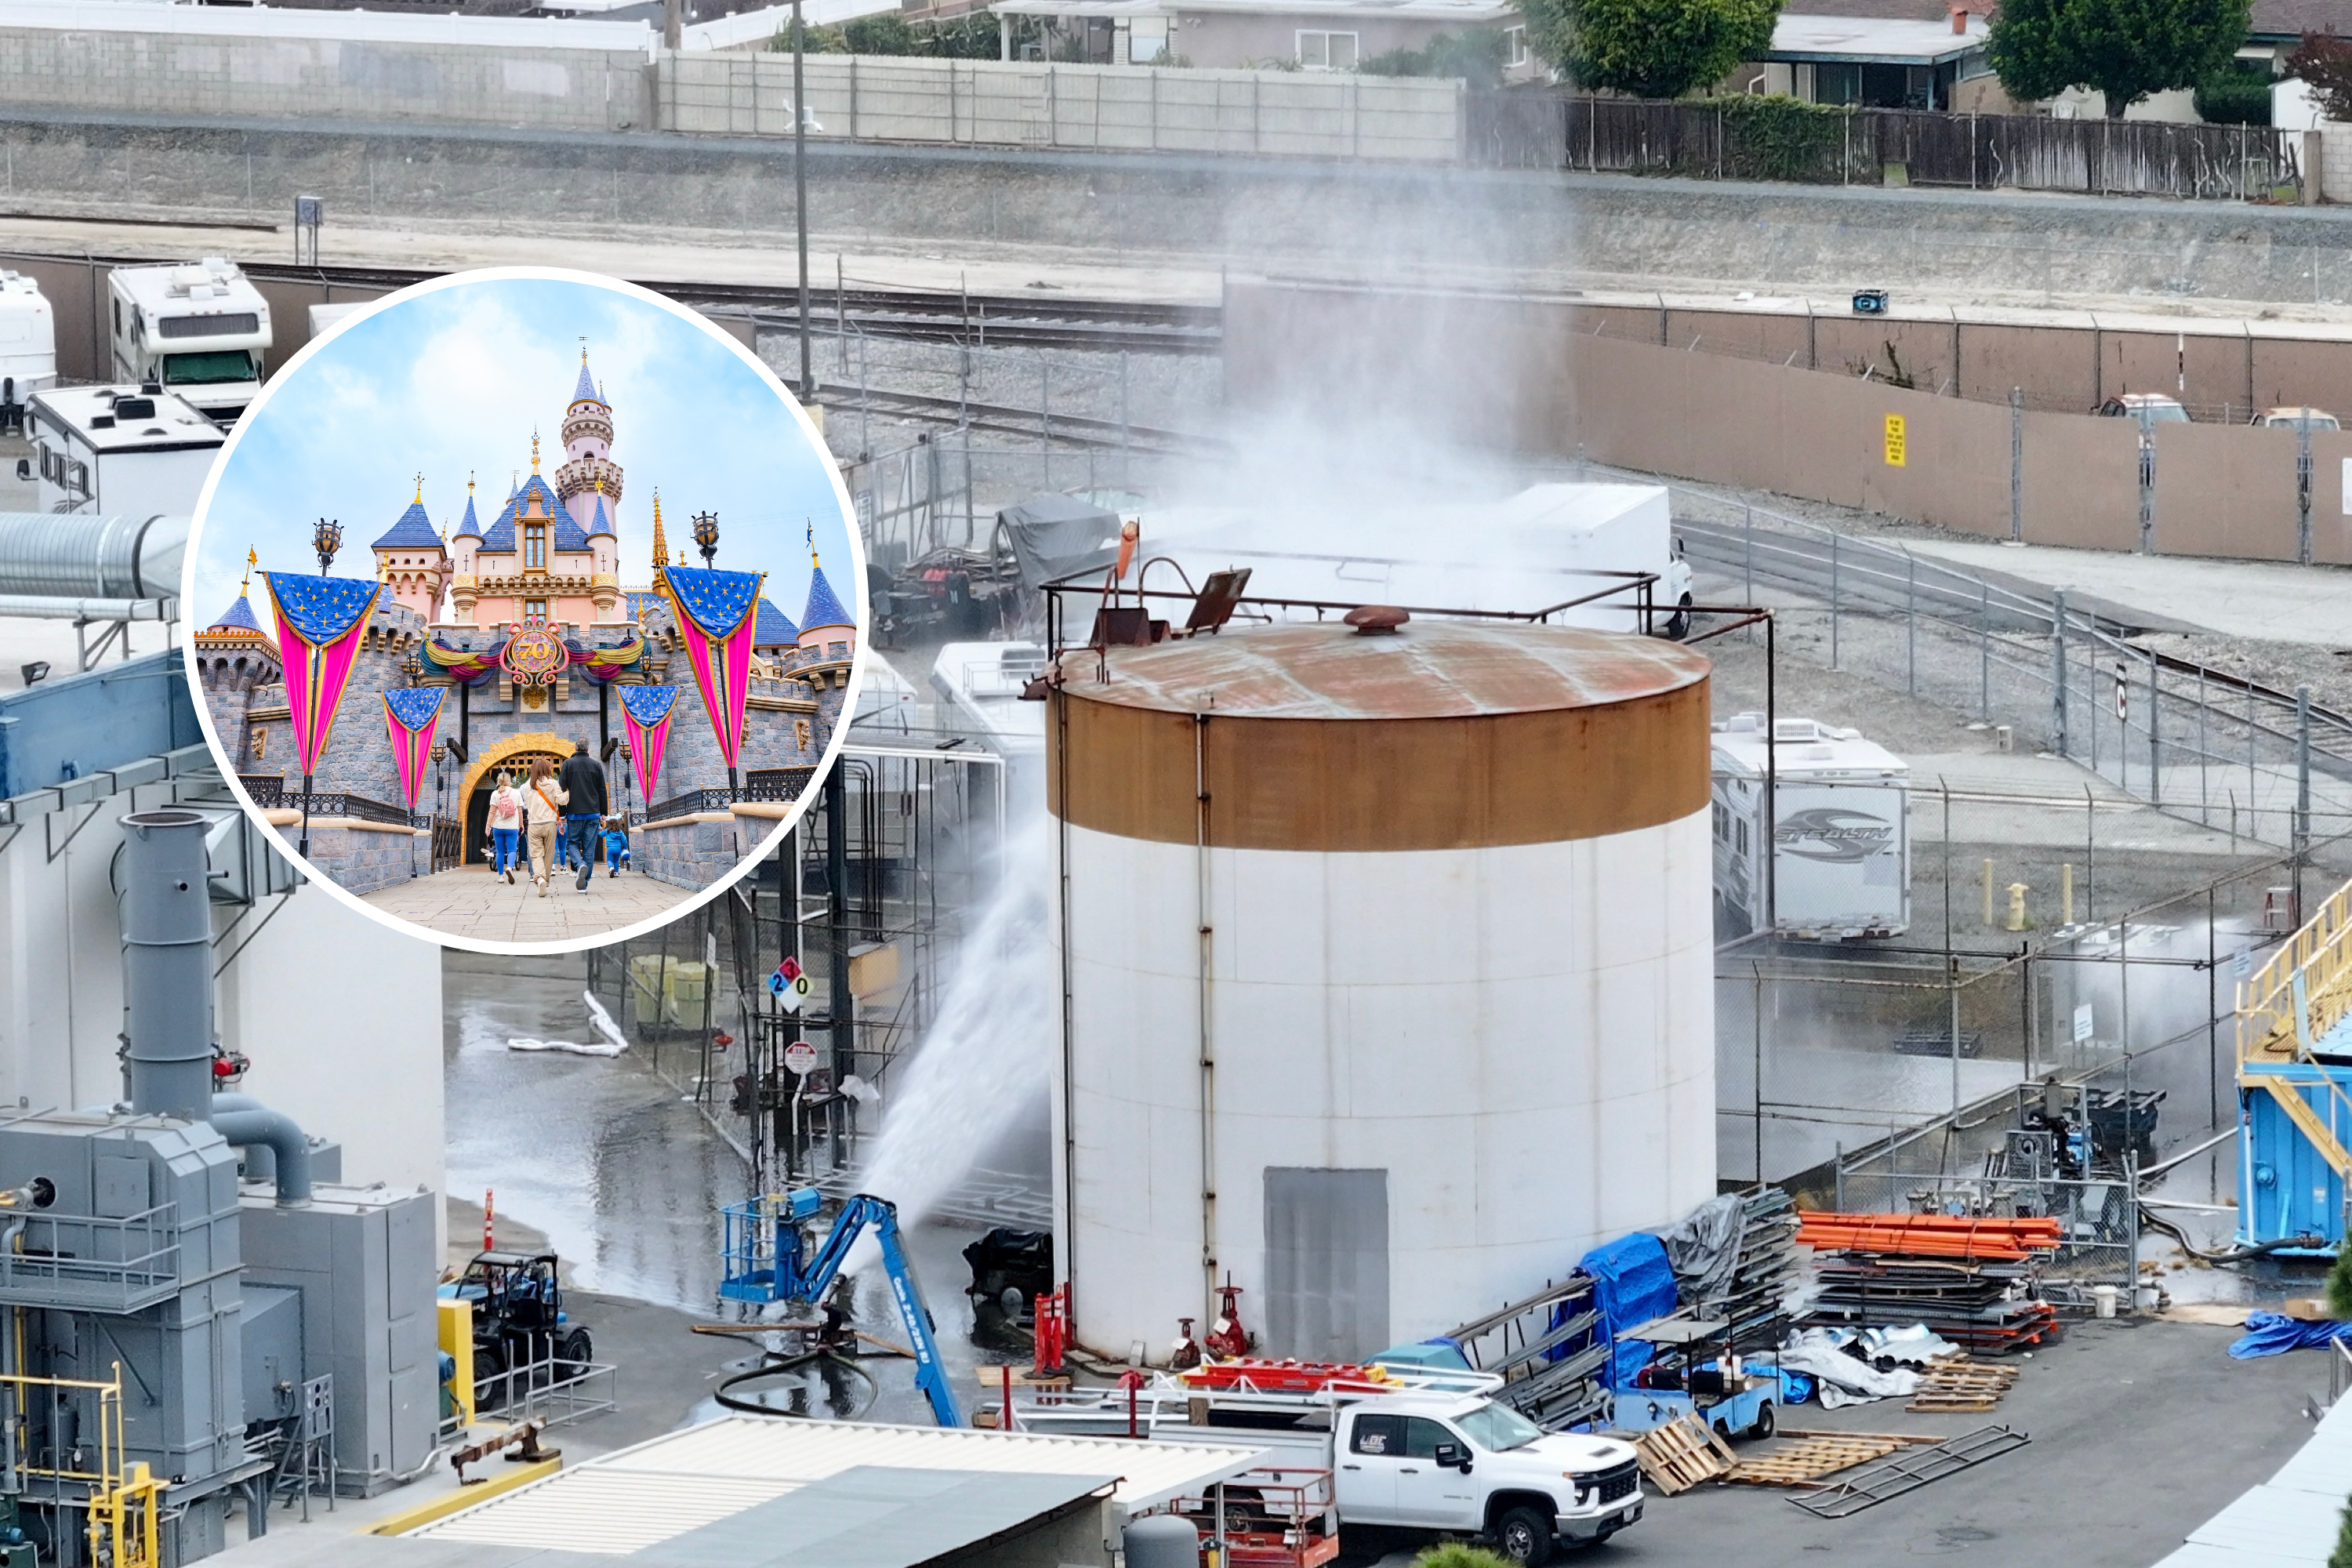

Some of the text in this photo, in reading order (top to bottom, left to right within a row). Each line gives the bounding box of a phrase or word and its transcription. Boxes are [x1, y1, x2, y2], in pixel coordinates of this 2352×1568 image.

[518, 642, 550, 661] 70
[2117, 684, 2125, 718] C
[1774, 827, 1893, 840] STEALTH
[786, 961, 795, 980] 3
[772, 974, 783, 992] 2
[797, 977, 808, 995] 0
